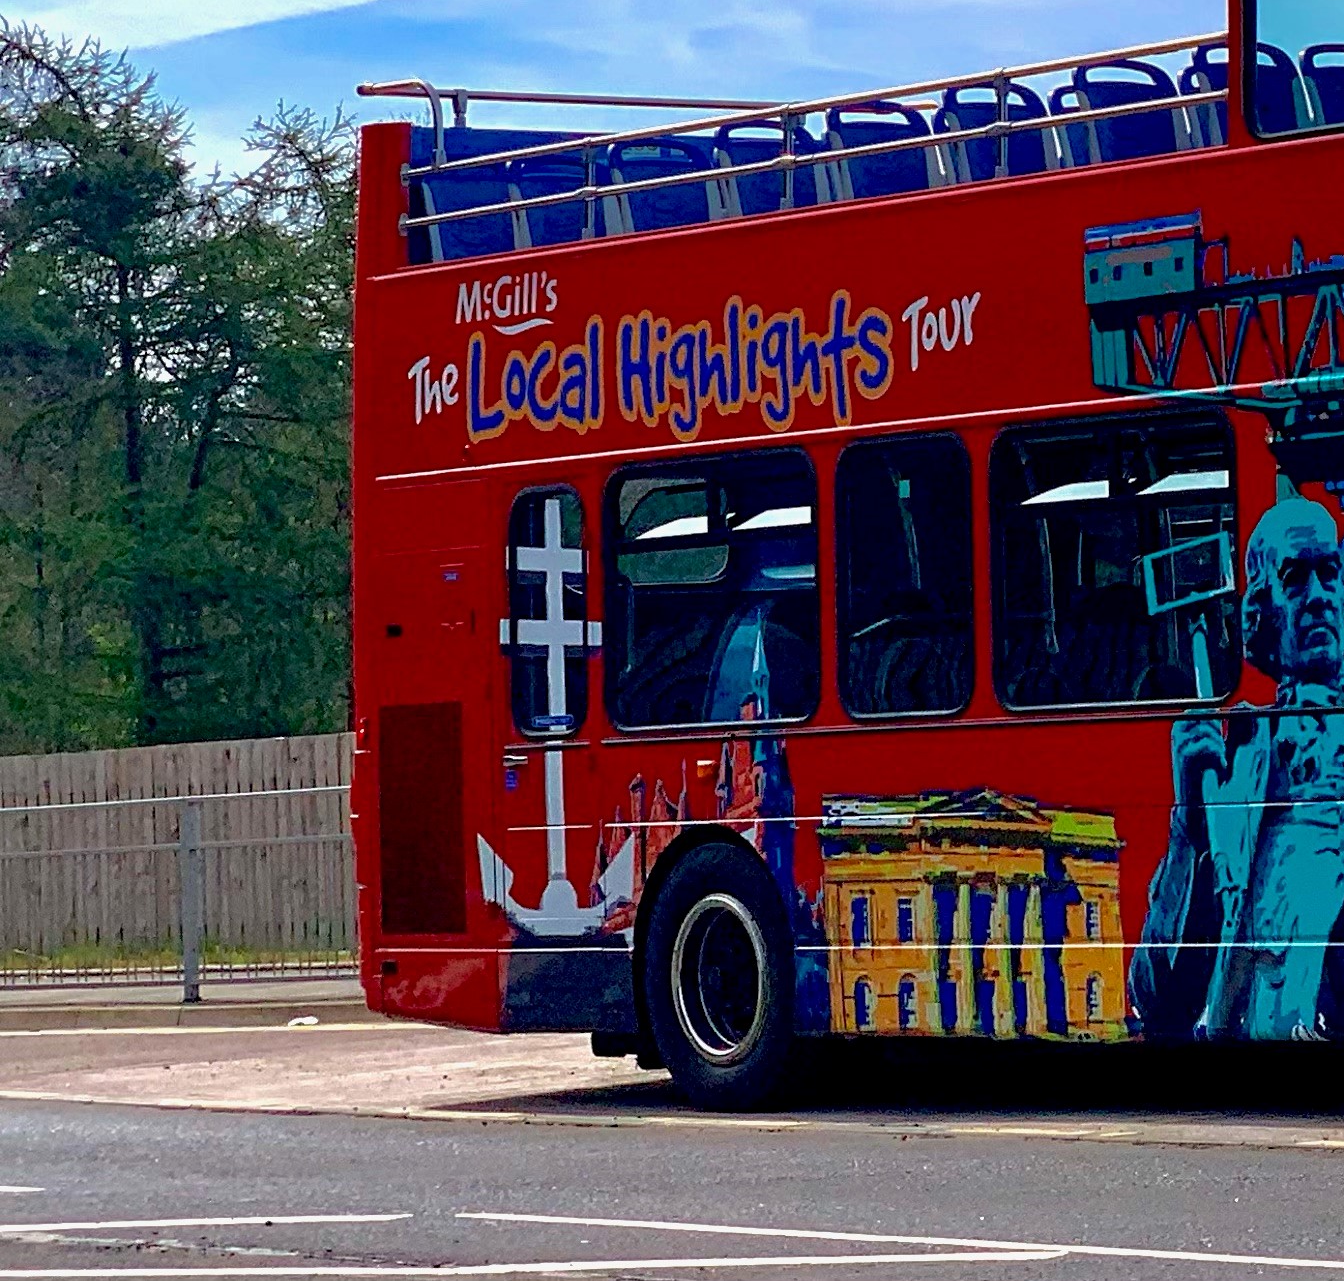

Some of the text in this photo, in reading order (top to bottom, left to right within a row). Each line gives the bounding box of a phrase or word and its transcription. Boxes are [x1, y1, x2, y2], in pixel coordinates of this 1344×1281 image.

[455, 271, 558, 324] McGill's
[407, 289, 980, 442] The Local Highlights Tour
